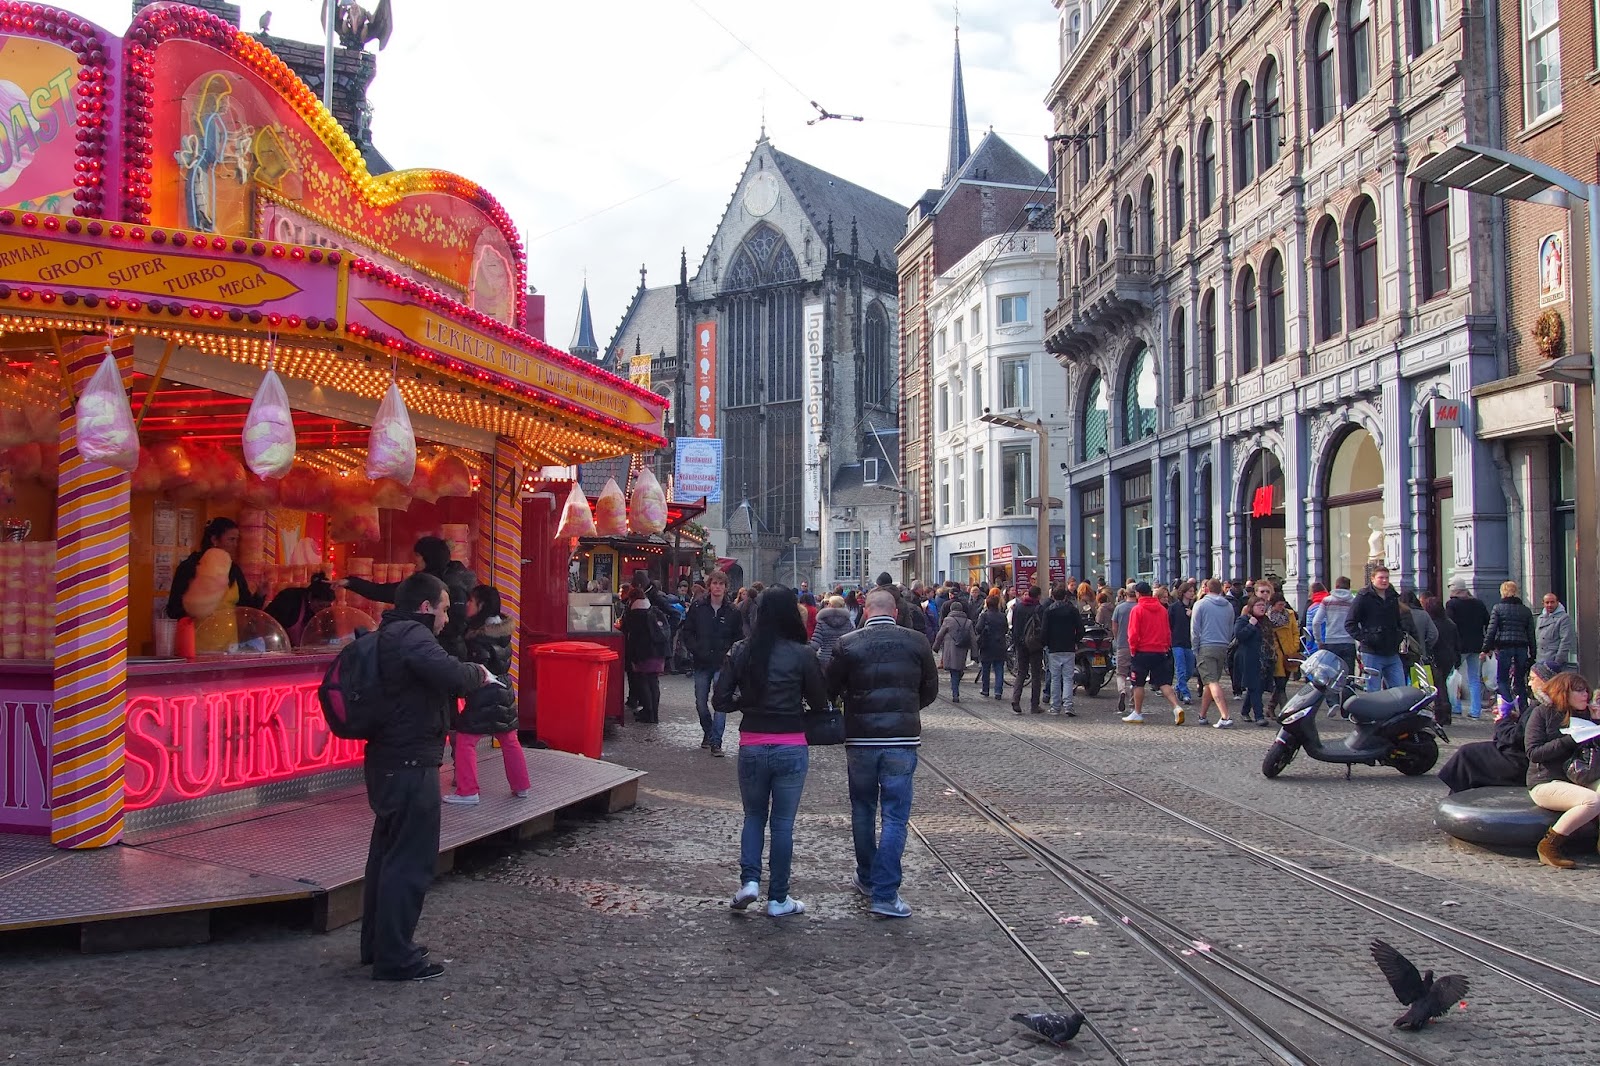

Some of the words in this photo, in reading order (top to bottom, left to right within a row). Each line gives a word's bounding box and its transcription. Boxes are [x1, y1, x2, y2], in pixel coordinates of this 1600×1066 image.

[0, 242, 50, 268] RMAAL
[38, 251, 104, 281] GROOT
[108, 257, 167, 286] SUPER
[163, 264, 226, 293] TURBO
[217, 273, 267, 298] MEGA
[425, 317, 496, 365] LEKKER
[500, 348, 532, 378] MET
[536, 363, 573, 394] TWEE
[576, 380, 629, 416] KLEUREN
[807, 312, 823, 434] Ingehuldigd!
[1436, 405, 1460, 421] H&M
[1020, 560, 1037, 568] HOT
[0, 701, 52, 811] IN
